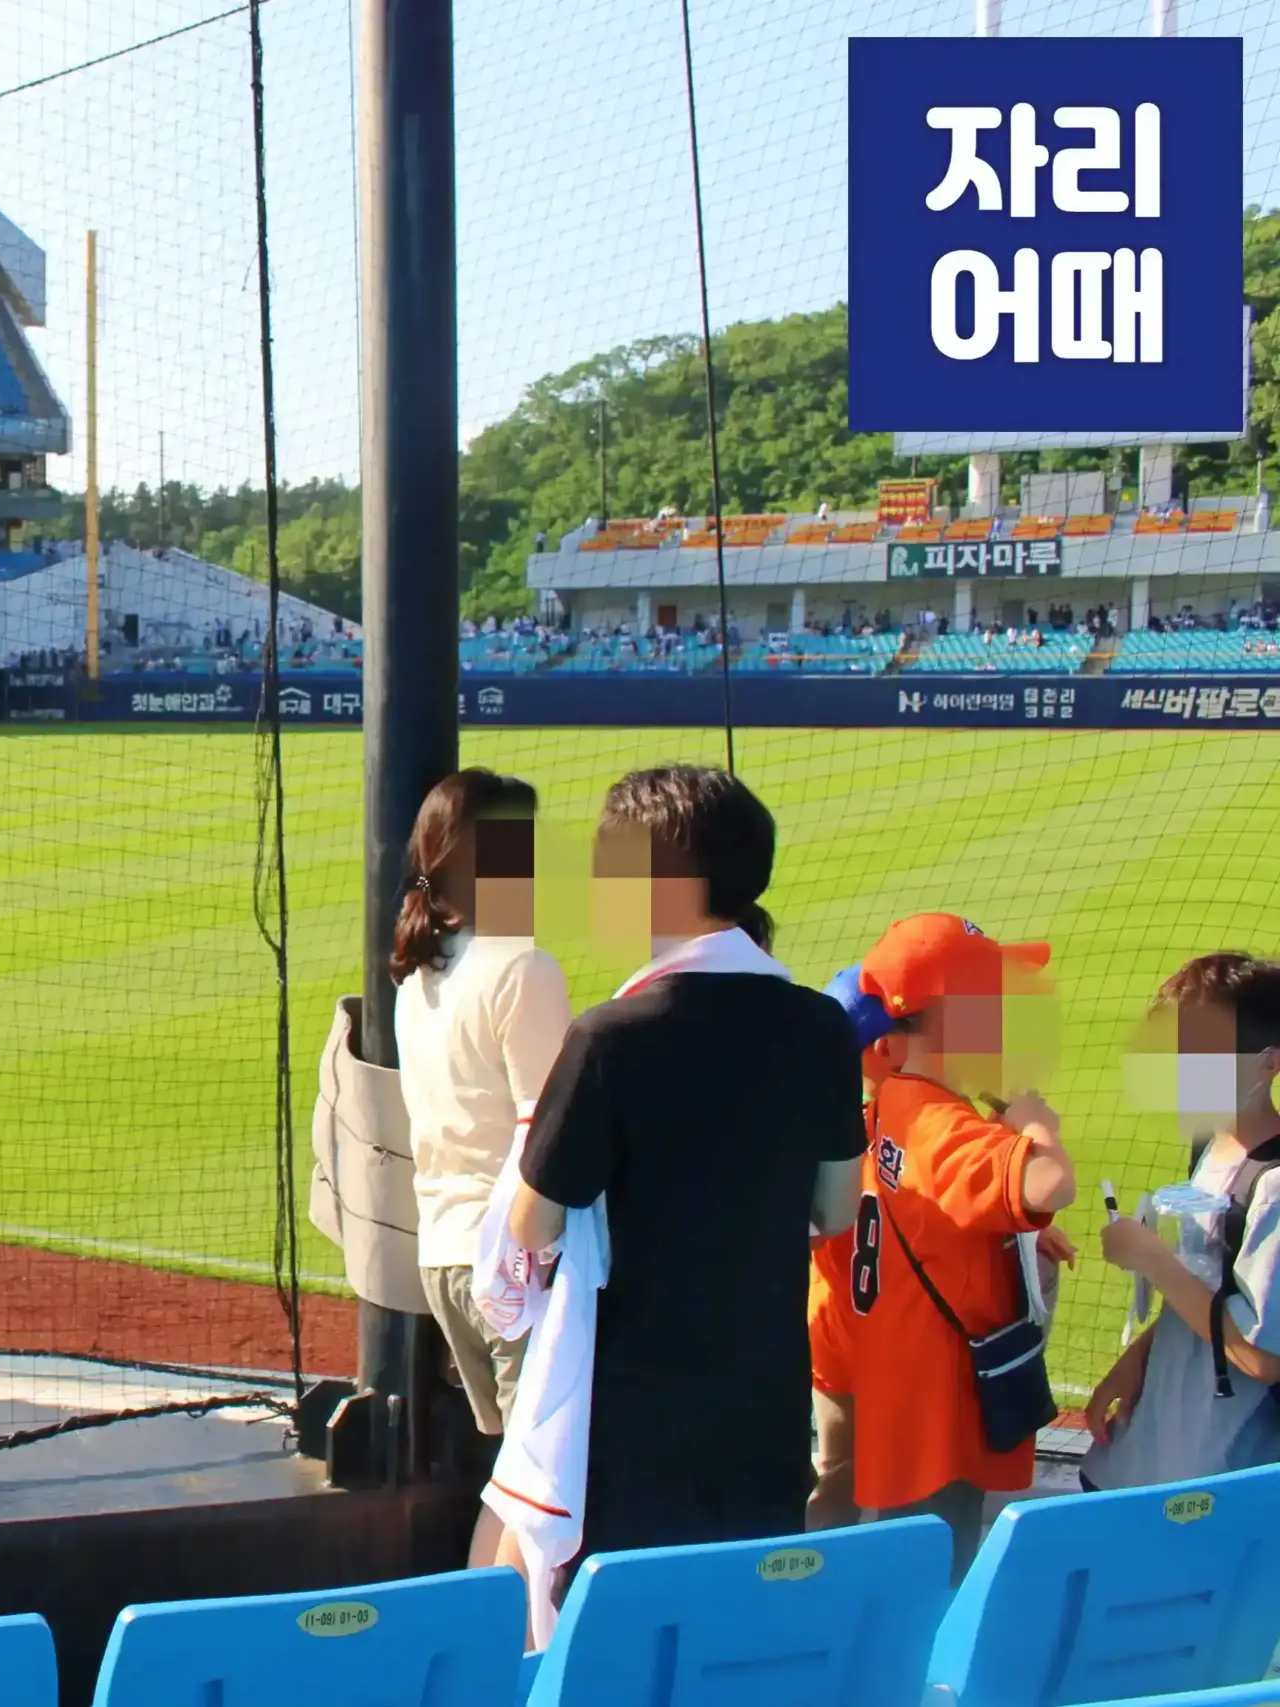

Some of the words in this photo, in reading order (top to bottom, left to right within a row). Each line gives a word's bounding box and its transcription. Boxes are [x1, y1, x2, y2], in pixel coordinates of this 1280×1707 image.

[923, 542, 1061, 576] 피자마루
[1121, 686, 1261, 719] 세신버팔로
[851, 1190, 881, 1316] 8
[305, 1611, 336, 1628] (1-09)
[339, 1609, 369, 1625] 01-03
